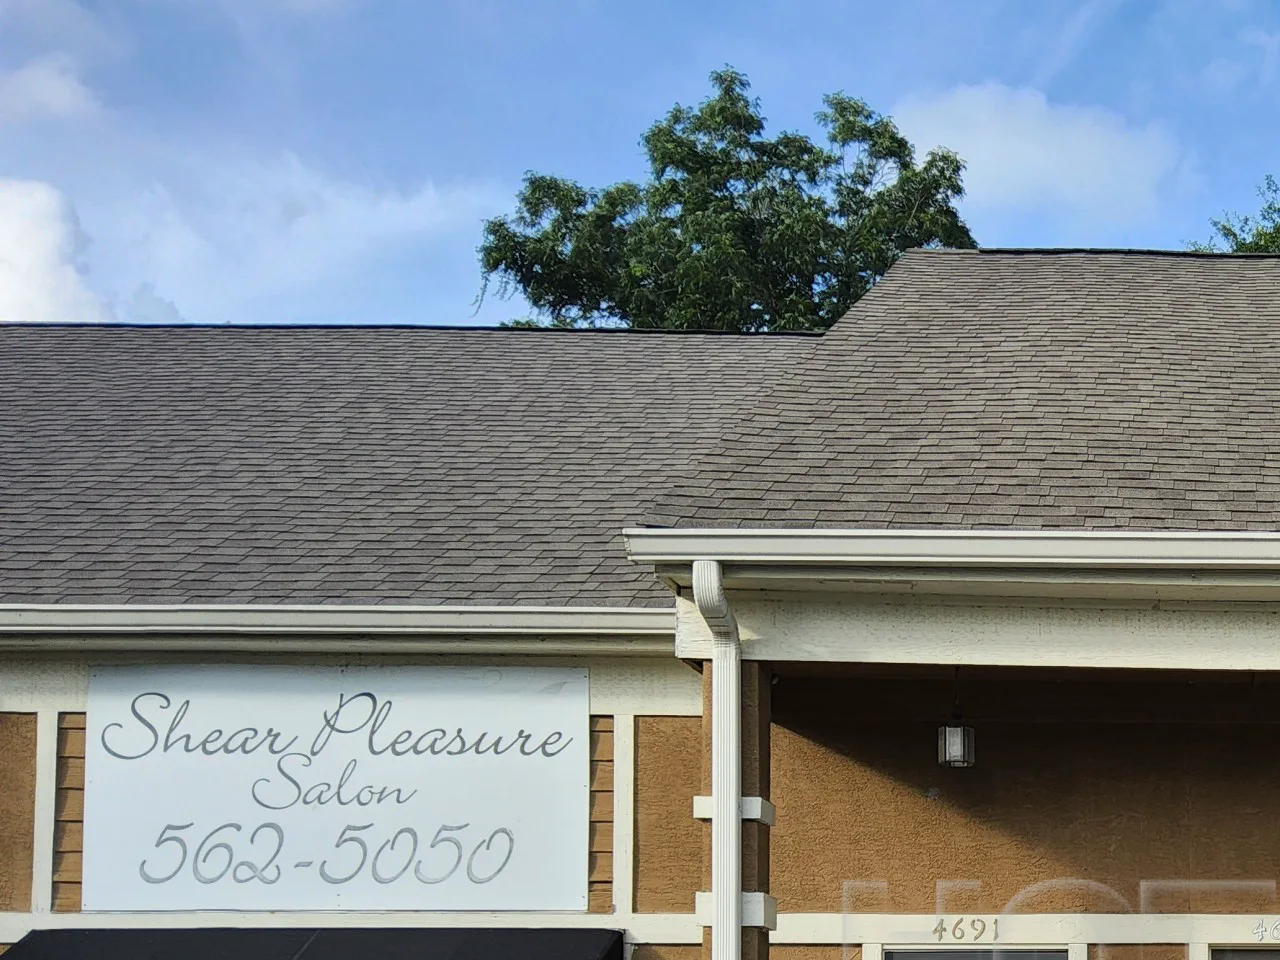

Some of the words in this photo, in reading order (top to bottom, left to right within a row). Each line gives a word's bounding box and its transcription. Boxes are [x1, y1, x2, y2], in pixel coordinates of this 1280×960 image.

[102, 692, 298, 760] Shear
[309, 692, 574, 758] Pleasure
[252, 753, 418, 810] Salon
[139, 821, 515, 885] 562-5050
[932, 918, 1001, 942] 4691
